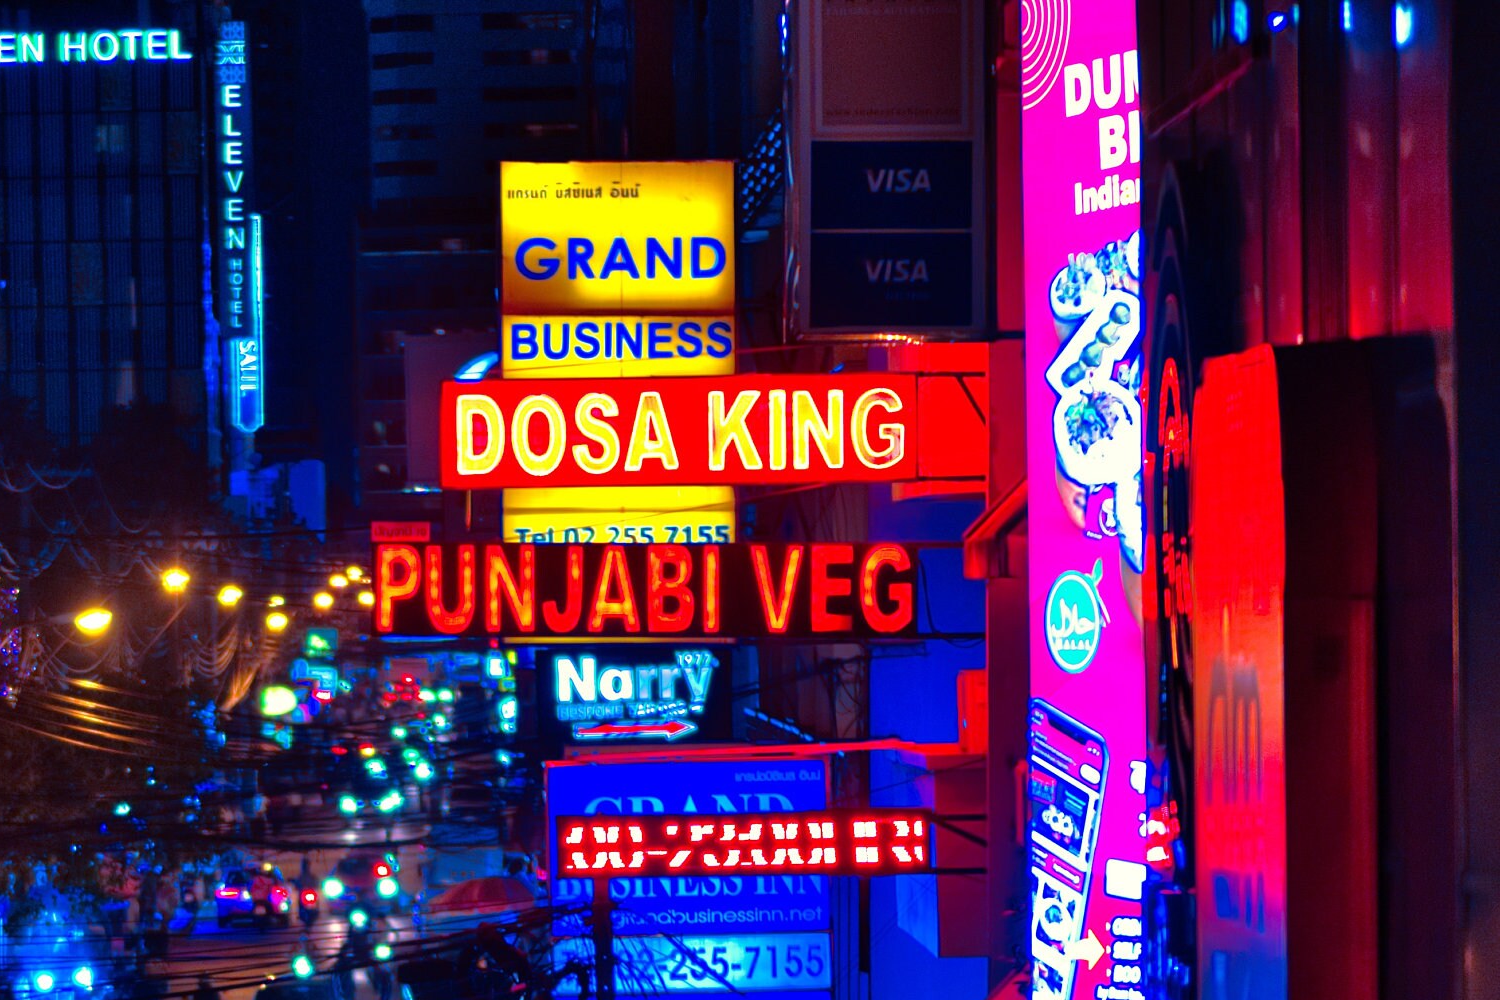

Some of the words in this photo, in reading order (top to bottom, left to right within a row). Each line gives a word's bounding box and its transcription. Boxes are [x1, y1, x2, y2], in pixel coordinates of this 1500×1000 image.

[59, 29, 193, 64] HOTEL
[221, 84, 244, 250] ELEVEN
[865, 169, 932, 193] VISA
[515, 236, 728, 282] GRAND
[865, 258, 931, 284] VISA
[229, 258, 244, 328] HOTEL
[511, 320, 733, 361] BUSINESS
[455, 391, 680, 477] DOSA
[707, 387, 906, 471] KING
[375, 543, 721, 634] PUNJABI
[752, 543, 914, 633] VEG
[555, 656, 715, 713] Narry
